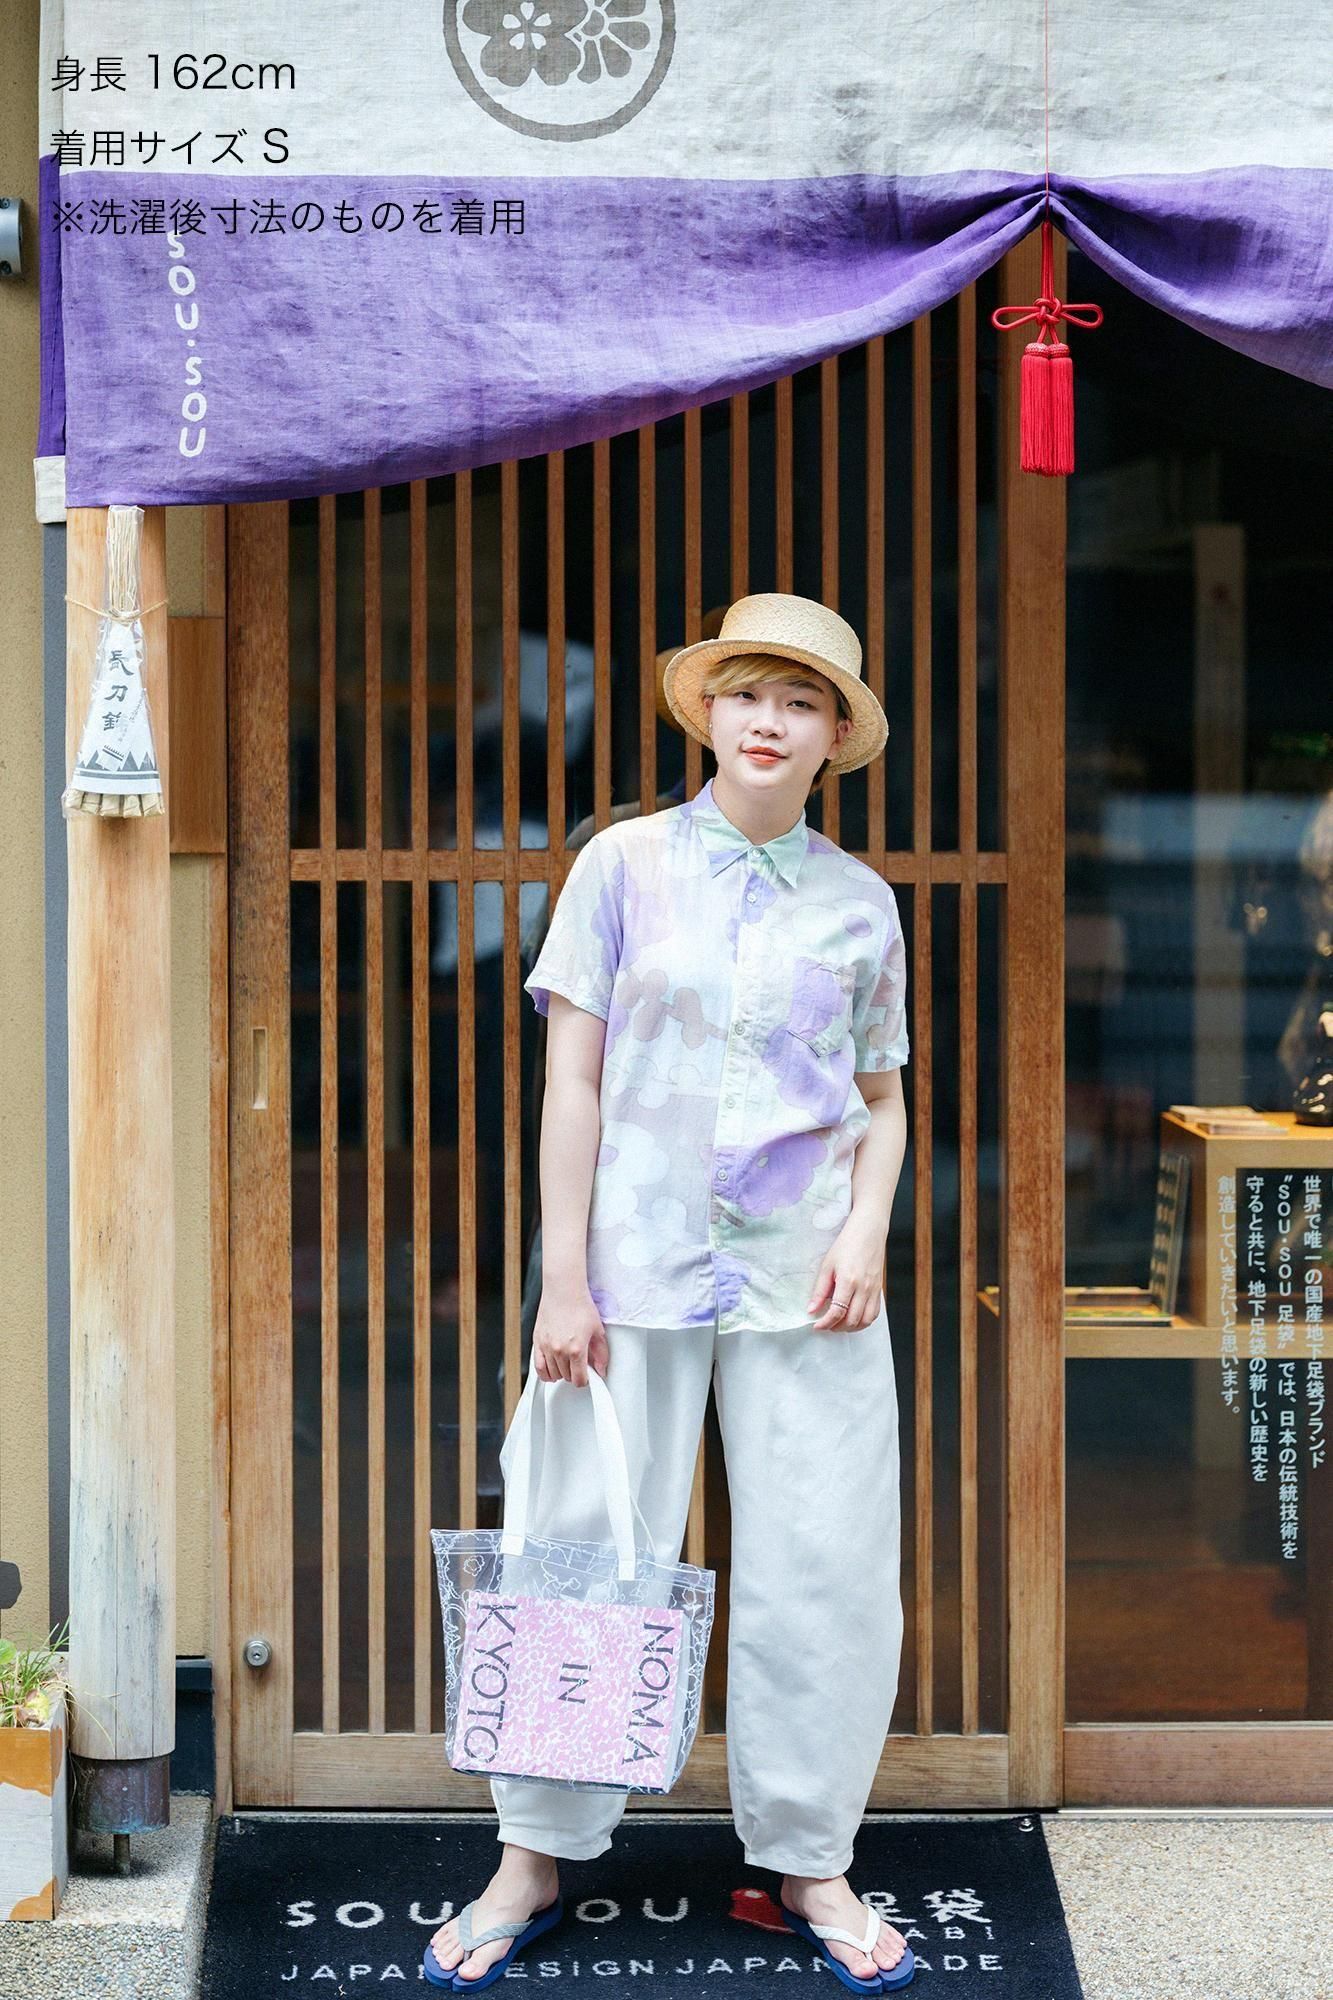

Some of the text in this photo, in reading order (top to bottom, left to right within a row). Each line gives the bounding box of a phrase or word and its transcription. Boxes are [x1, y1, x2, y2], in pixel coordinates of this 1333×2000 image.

[1217, 1175, 1240, 1414] 創造していきたいと思います。
[1246, 1175, 1269, 1482] 守ると共に、地下足袋の新しい歴史を
[1303, 1175, 1326, 1469] 世界で唯一の国産地下足袋ブランド
[463, 1603, 518, 1764] KYOTO
[558, 1662, 592, 1705] IN
[622, 1622, 676, 1765] NOMA
[281, 1963, 425, 1980] JAPA
[504, 1959, 654, 1978] ESIGN
[913, 1954, 1003, 1971] ADE
[575, 1897, 689, 1923] OU
[905, 1926, 995, 1941] ABI
